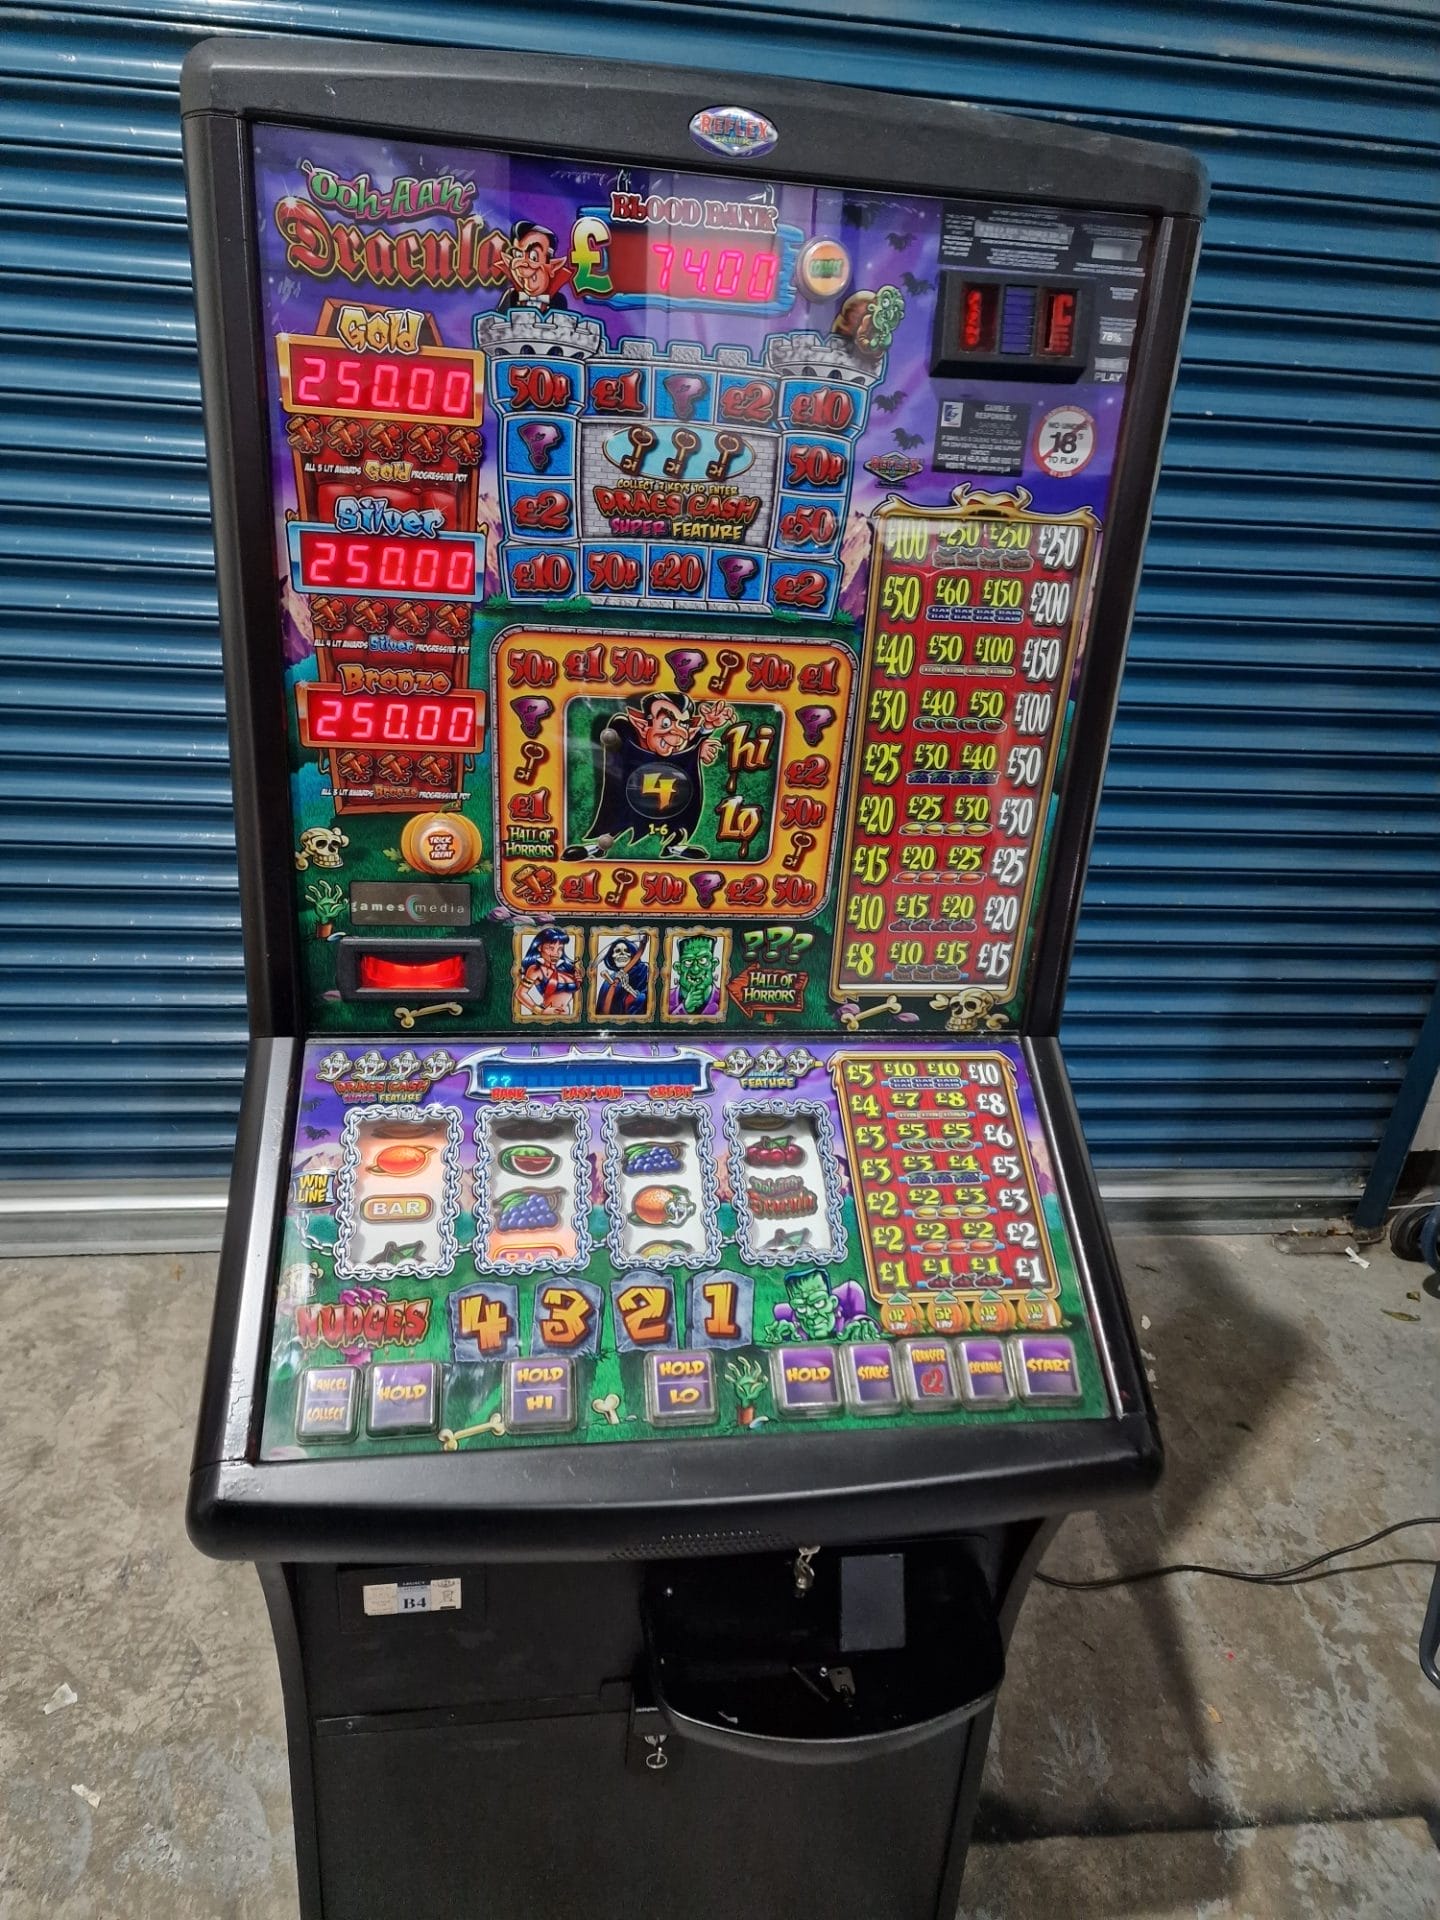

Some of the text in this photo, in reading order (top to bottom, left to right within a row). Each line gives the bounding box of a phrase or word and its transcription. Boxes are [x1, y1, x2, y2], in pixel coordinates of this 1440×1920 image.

[700, 113, 768, 141] REFLEX
[705, 200, 778, 233] BANK
[275, 197, 512, 287] Dracula
[337, 305, 424, 354] Gold
[298, 357, 471, 414] 250.00
[590, 368, 646, 413] £1
[721, 382, 775, 424] £2
[790, 385, 854, 429] £10
[617, 479, 654, 491] COLLECT
[708, 485, 738, 496] ENTER
[335, 497, 445, 539] Silver
[512, 490, 571, 529] £2
[593, 486, 762, 524] DRACS CASH
[611, 518, 743, 540] SUPER FEATURE
[779, 507, 837, 544] £50
[1038, 526, 1080, 568] £250
[310, 542, 473, 590] 250.00
[512, 551, 573, 592] £10
[649, 552, 703, 591] £20
[773, 569, 828, 606] £2
[882, 576, 921, 620] £50
[936, 577, 970, 606] £60
[983, 579, 1023, 608] £150
[1029, 582, 1071, 625] £200
[563, 644, 839, 694] £1 £1
[876, 633, 1060, 680] £40 £50 £100 £150
[337, 663, 452, 696] Bronze
[316, 700, 474, 742] 250.00
[870, 690, 1052, 733] £30 £40 £50 £100
[785, 755, 830, 788] £2
[865, 744, 1042, 786] £25 £30 £40 £50
[507, 788, 550, 822] £1
[641, 772, 677, 811] 4
[648, 824, 669, 836] 1-6
[859, 795, 1034, 836] £20 £25 £30 £30
[428, 835, 452, 845] TRICK
[435, 843, 448, 851] OR
[505, 842, 555, 858] HORRORS
[510, 827, 555, 844] HALL OF
[429, 850, 454, 860] TREAT
[853, 846, 1027, 885] £15 £20 £25 £25
[560, 870, 768, 907] £1 £2
[415, 903, 465, 914] media
[849, 894, 1018, 932] £10 £15 £20 £20
[846, 943, 875, 976] £8
[890, 942, 923, 965] £10
[935, 942, 970, 965] £15
[977, 943, 1013, 977] £15
[750, 972, 797, 989] HALL OF
[743, 987, 796, 1004] HORRORS
[740, 1077, 795, 1088] FEATURE
[847, 1064, 874, 1087] £5
[884, 1062, 916, 1077] £10
[928, 1062, 961, 1077] £10
[968, 1064, 999, 1085] £10
[491, 1088, 526, 1099] BANK
[595, 1087, 622, 1098] WIN
[851, 1094, 880, 1119] £4
[891, 1092, 920, 1108] £7
[935, 1092, 966, 1107] £8
[977, 1093, 1006, 1116] £8
[856, 1123, 1013, 1150] £3 £5 £5 £6
[299, 1174, 328, 1190] WIN
[861, 1156, 1019, 1182] £3 £3 £4 £5
[298, 1188, 326, 1203] LINE
[373, 1201, 421, 1215] BAR
[867, 1188, 1029, 1216] £2 £2 £3 £3
[873, 1222, 1038, 1251] £2 £2 £2 £2
[879, 1257, 1045, 1287] £1 £1 £1 £1
[295, 1299, 431, 1349] NUDGES
[460, 1282, 741, 1353] 4 3 2 1
[517, 1367, 564, 1382] HOLD
[659, 1361, 705, 1377] HOLD
[786, 1367, 831, 1382] HOLD
[857, 1365, 889, 1381] STAKE
[1026, 1358, 1071, 1372] START
[309, 1376, 348, 1392] CANCEL
[377, 1385, 427, 1400] HOLD
[669, 1388, 700, 1404] LO
[306, 1406, 346, 1423] COLLECT
[526, 1395, 553, 1410] HI
[403, 1597, 426, 1609] B4
